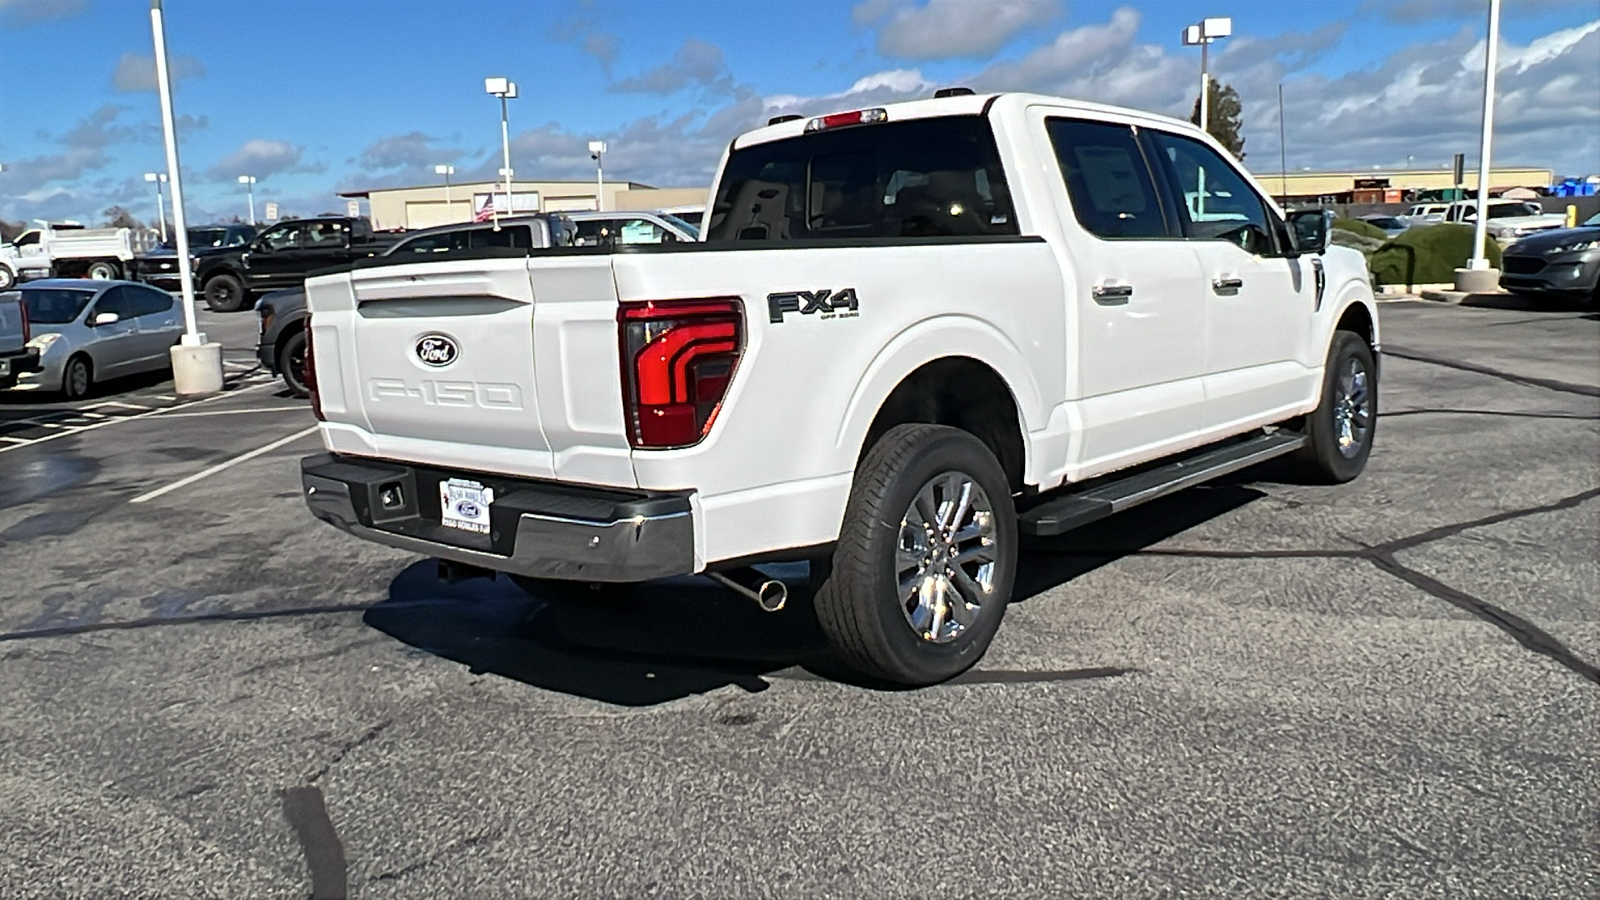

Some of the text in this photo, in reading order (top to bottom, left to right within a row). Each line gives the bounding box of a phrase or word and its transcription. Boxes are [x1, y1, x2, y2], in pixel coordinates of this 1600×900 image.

[767, 288, 859, 324] FX4
[419, 339, 451, 362] Ford
[368, 377, 524, 412] F-150
